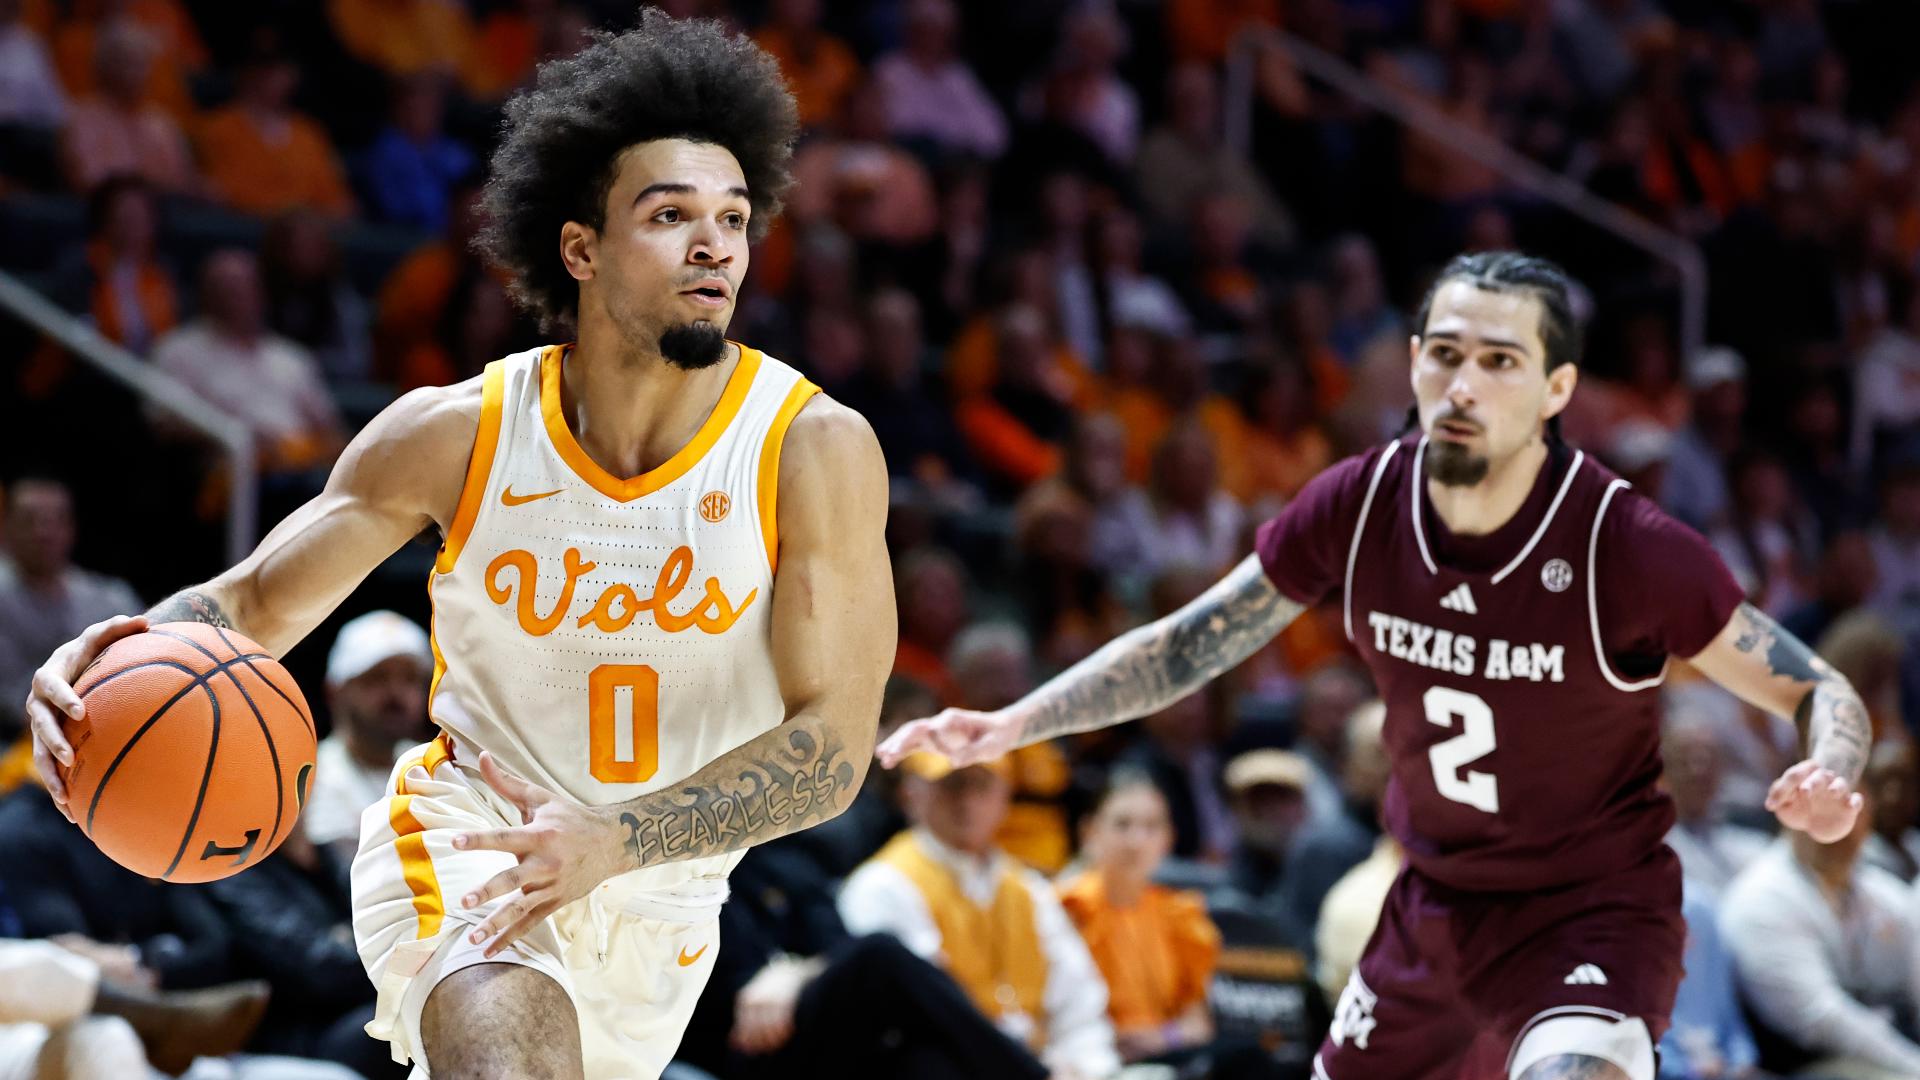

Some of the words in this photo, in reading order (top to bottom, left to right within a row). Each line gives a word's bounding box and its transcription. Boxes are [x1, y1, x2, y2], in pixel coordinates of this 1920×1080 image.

[702, 494, 728, 519] SEC
[484, 545, 758, 636] Vols
[1368, 610, 1476, 676] TEXAS
[1484, 639, 1565, 682] A&M
[588, 664, 659, 783] 0
[1423, 685, 1499, 813] 2
[634, 759, 836, 867] FEARLESS
